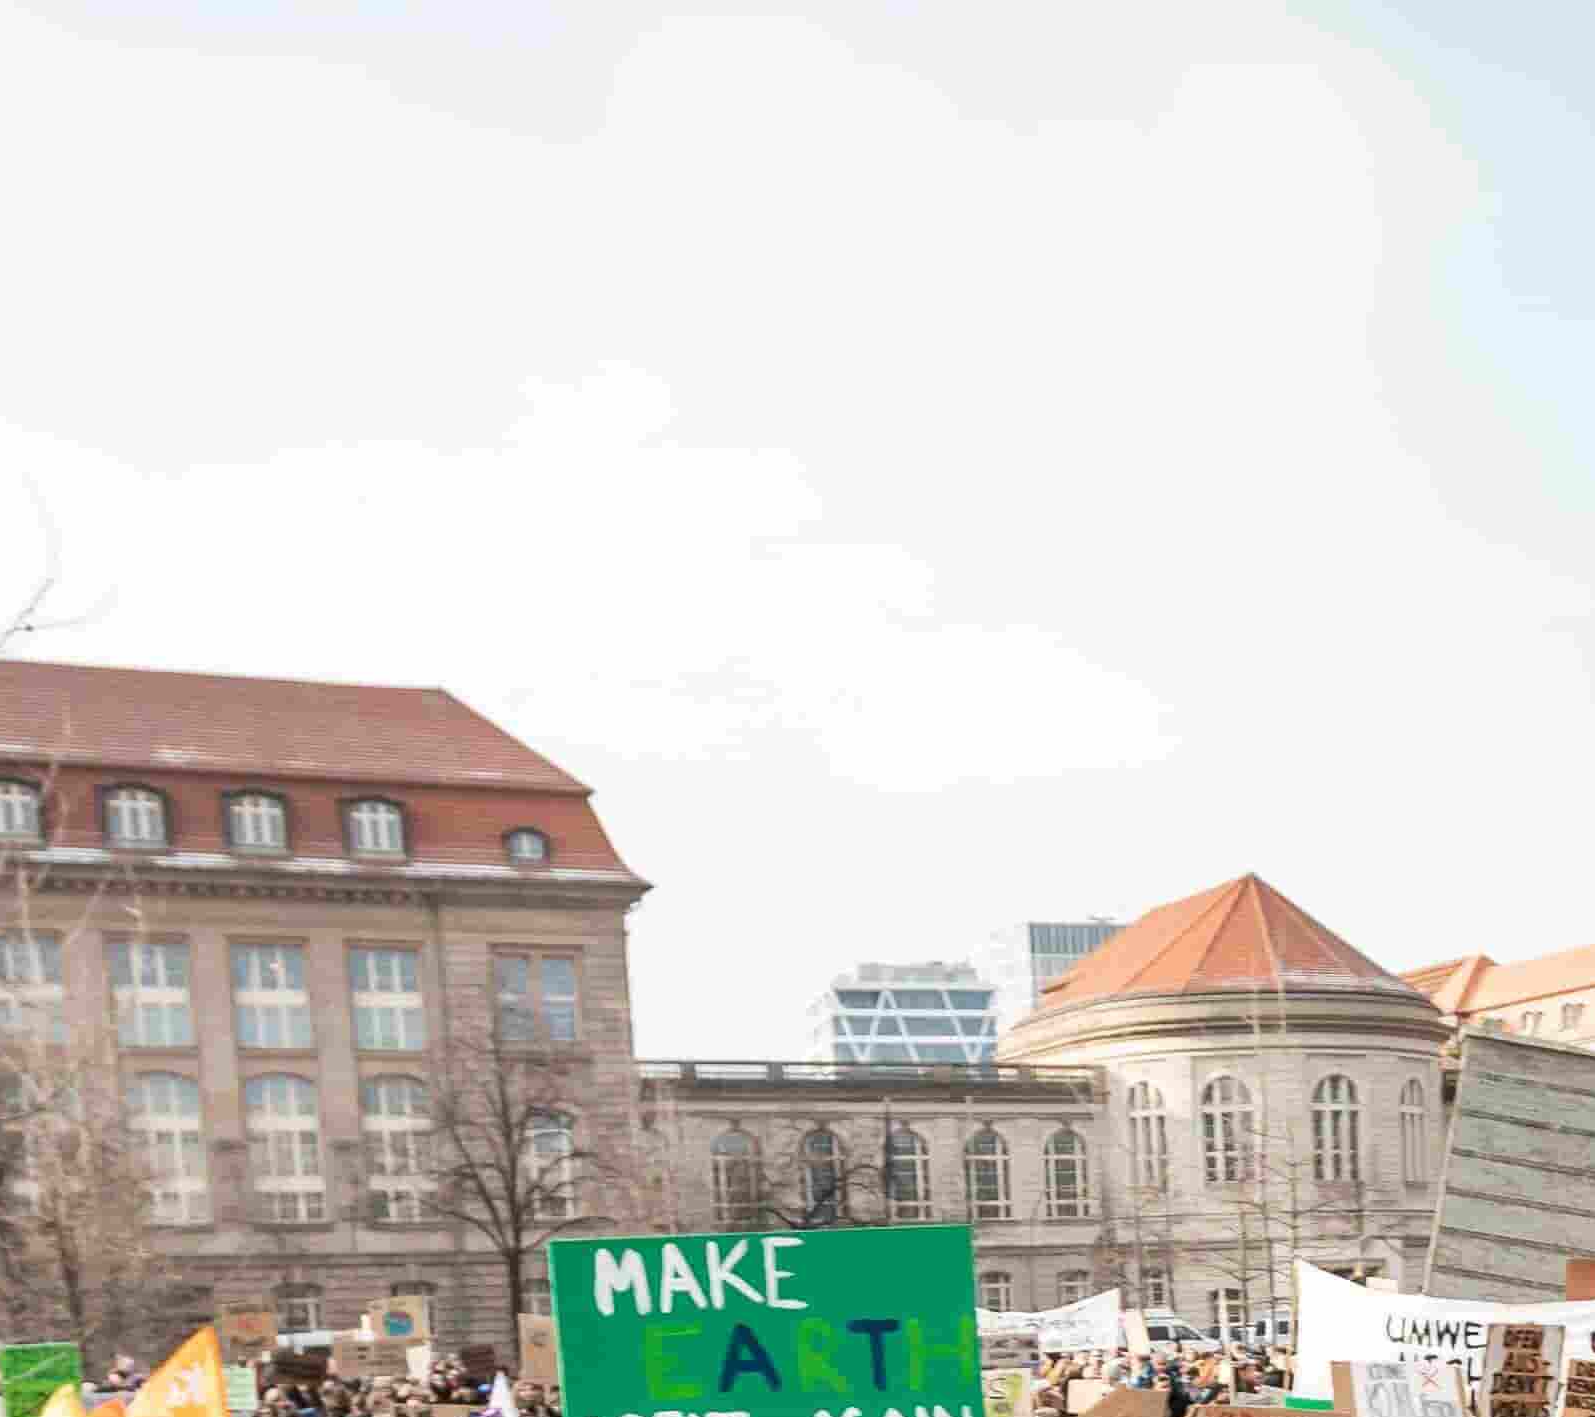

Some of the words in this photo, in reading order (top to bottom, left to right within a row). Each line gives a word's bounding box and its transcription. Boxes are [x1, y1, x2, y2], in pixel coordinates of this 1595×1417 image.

[593, 1238, 809, 1317] MAKE
[644, 1319, 974, 1401] EARTH
[1386, 1312, 1488, 1350] UMWE
